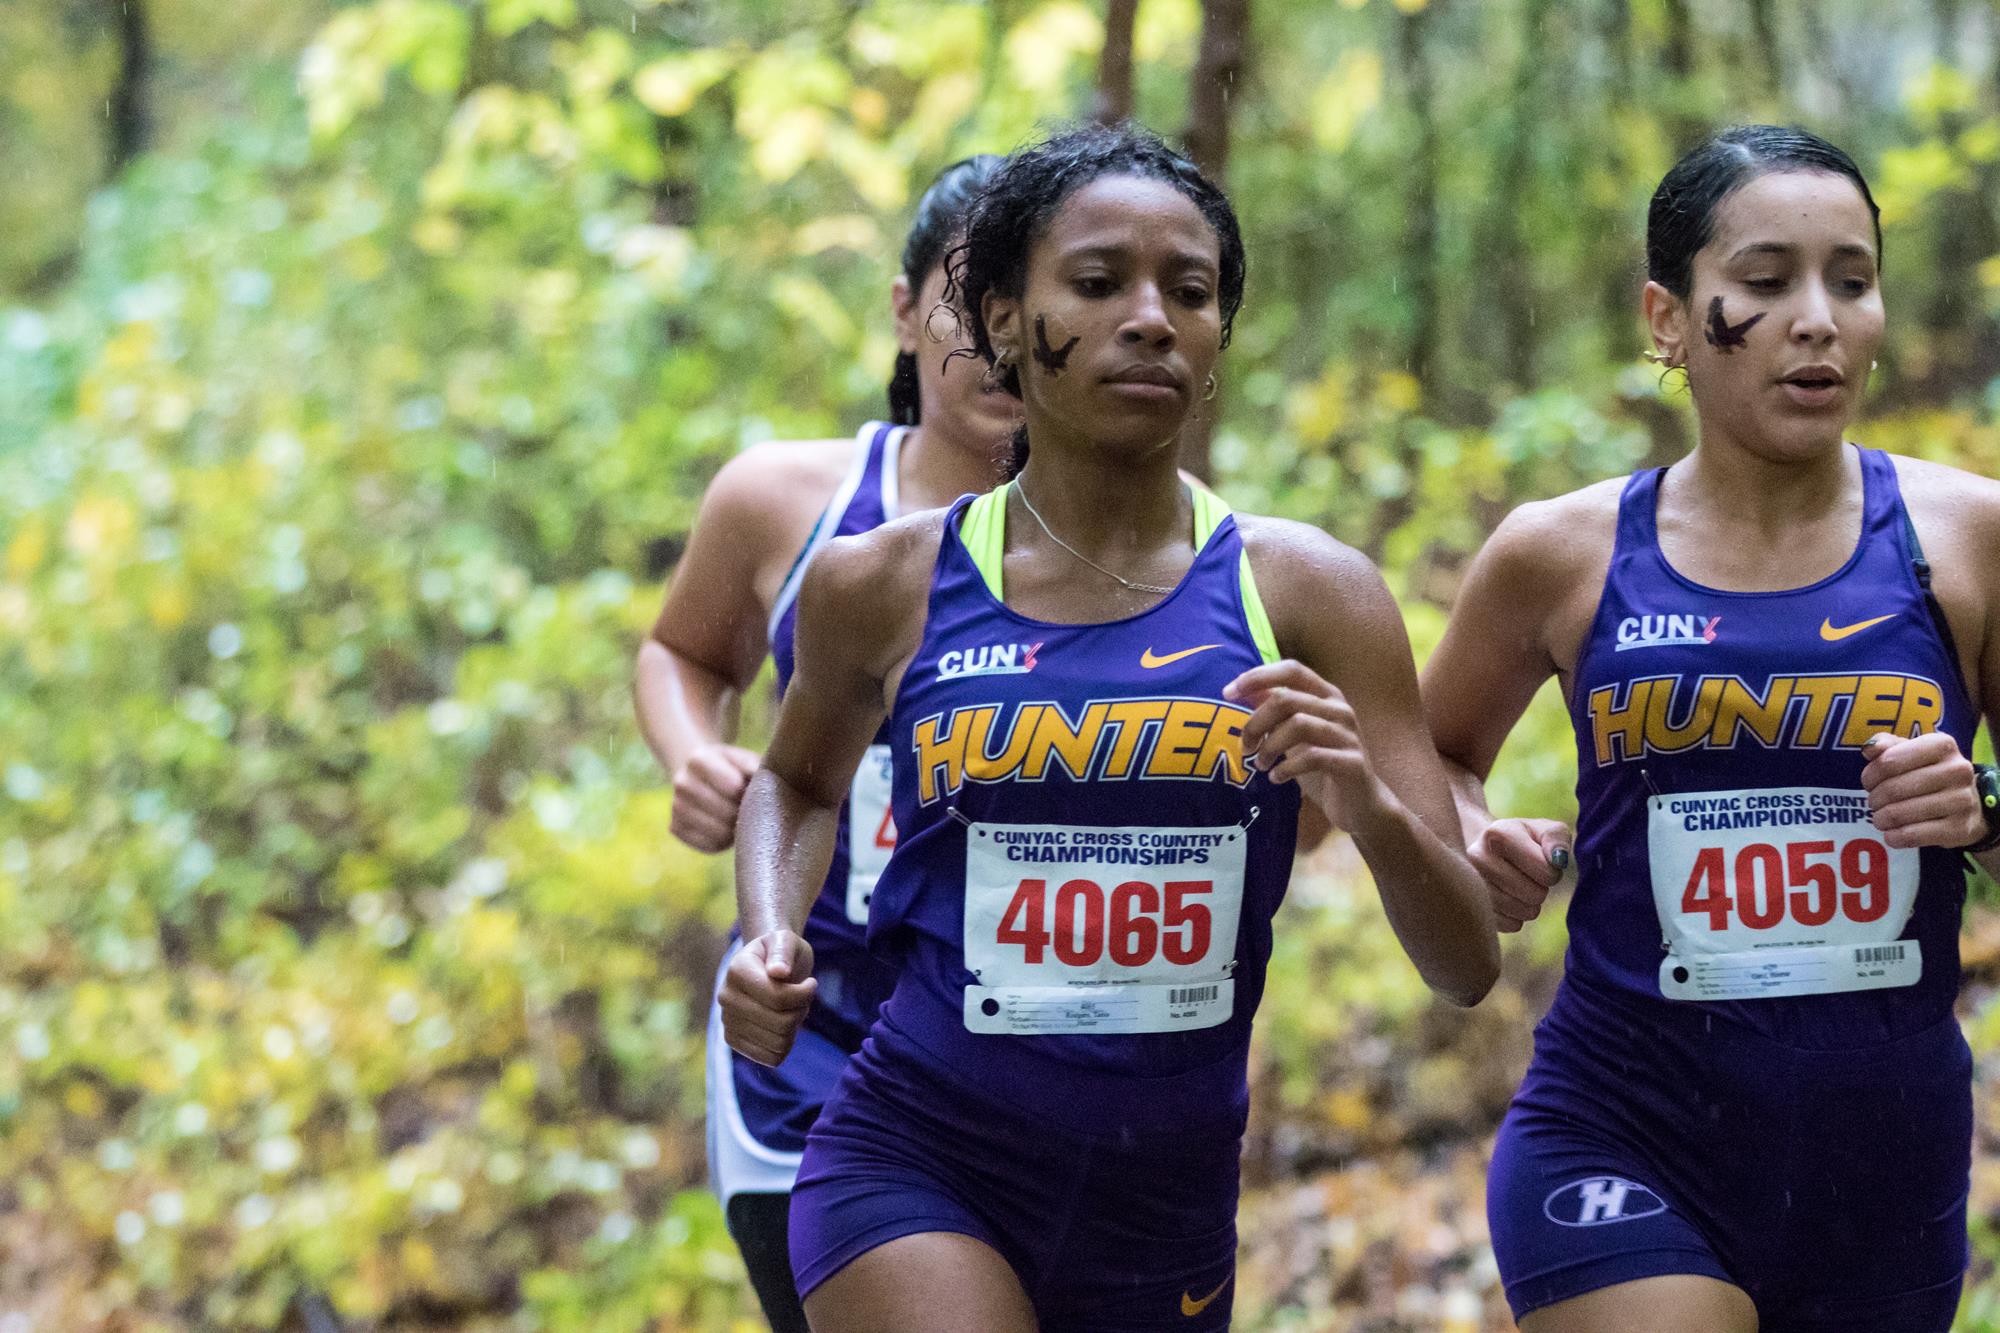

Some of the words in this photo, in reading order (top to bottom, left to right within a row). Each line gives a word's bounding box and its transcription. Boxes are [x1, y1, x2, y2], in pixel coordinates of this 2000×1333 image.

[1615, 614, 1722, 648] CUNY
[937, 641, 1043, 677] CUNY
[1588, 671, 1944, 768] HUNTER
[913, 696, 1261, 807] HUNTER
[1670, 798, 1740, 815] CUNYAC
[1746, 794, 1805, 810] CROSS
[1809, 794, 1868, 808] COUNT
[993, 830, 1067, 846] CUNYAC
[1072, 832, 1133, 847] CROSS
[1138, 833, 1224, 848] COUNTRY
[1006, 846, 1210, 866] CHAMPIONSHIPS
[1681, 838, 1890, 931] 4059
[996, 878, 1213, 967] 4065
[1578, 1179, 1629, 1224] H
